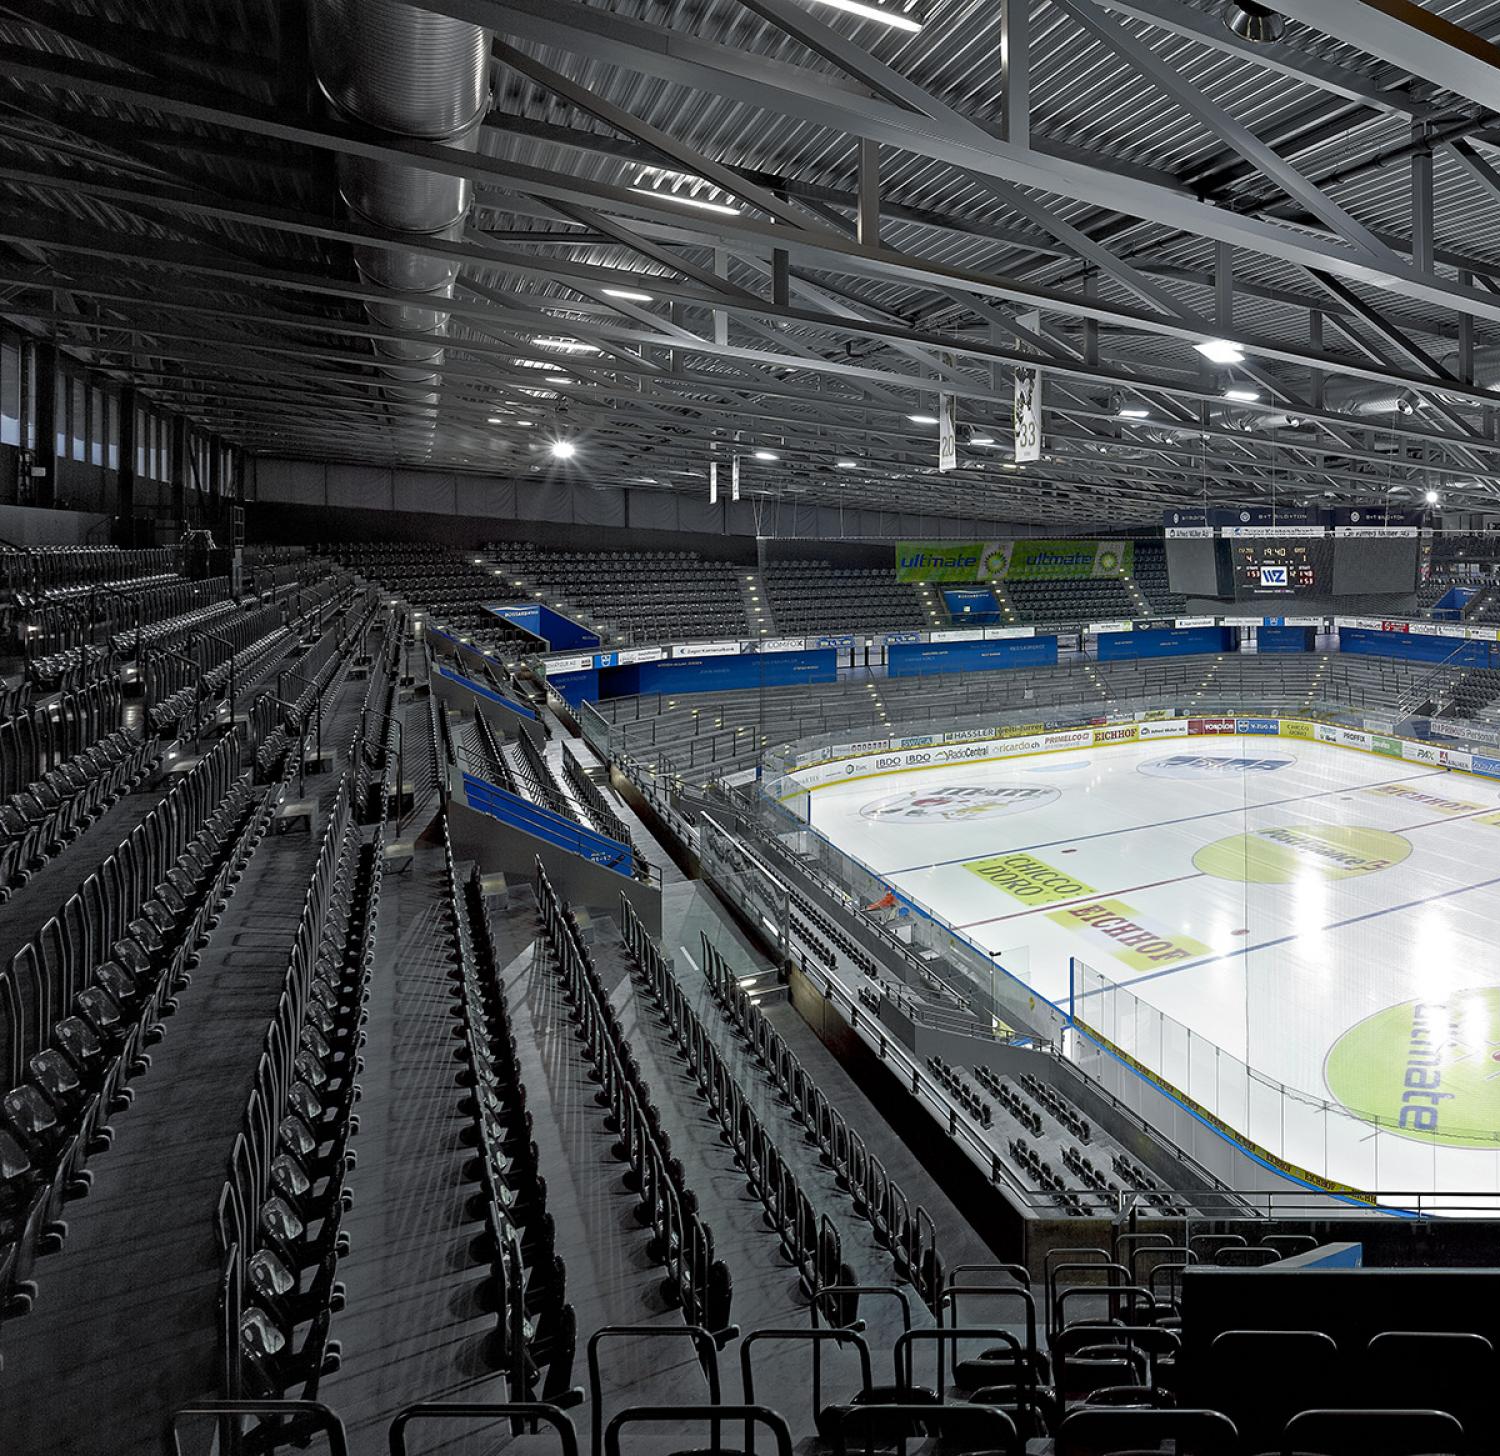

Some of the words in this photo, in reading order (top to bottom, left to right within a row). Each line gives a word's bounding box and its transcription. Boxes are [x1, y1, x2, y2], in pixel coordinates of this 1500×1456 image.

[1020, 421, 1036, 448] 33
[901, 553, 976, 568] ultimate
[1026, 552, 1092, 566] ultimate
[954, 728, 993, 739] HASSLER
[1044, 734, 1082, 745] PRIMELCO
[1094, 728, 1137, 742] EICHHOF
[947, 745, 989, 760] RadioCentral
[1004, 856, 1082, 895] CHICCO
[1068, 904, 1191, 961] EICHHOF
